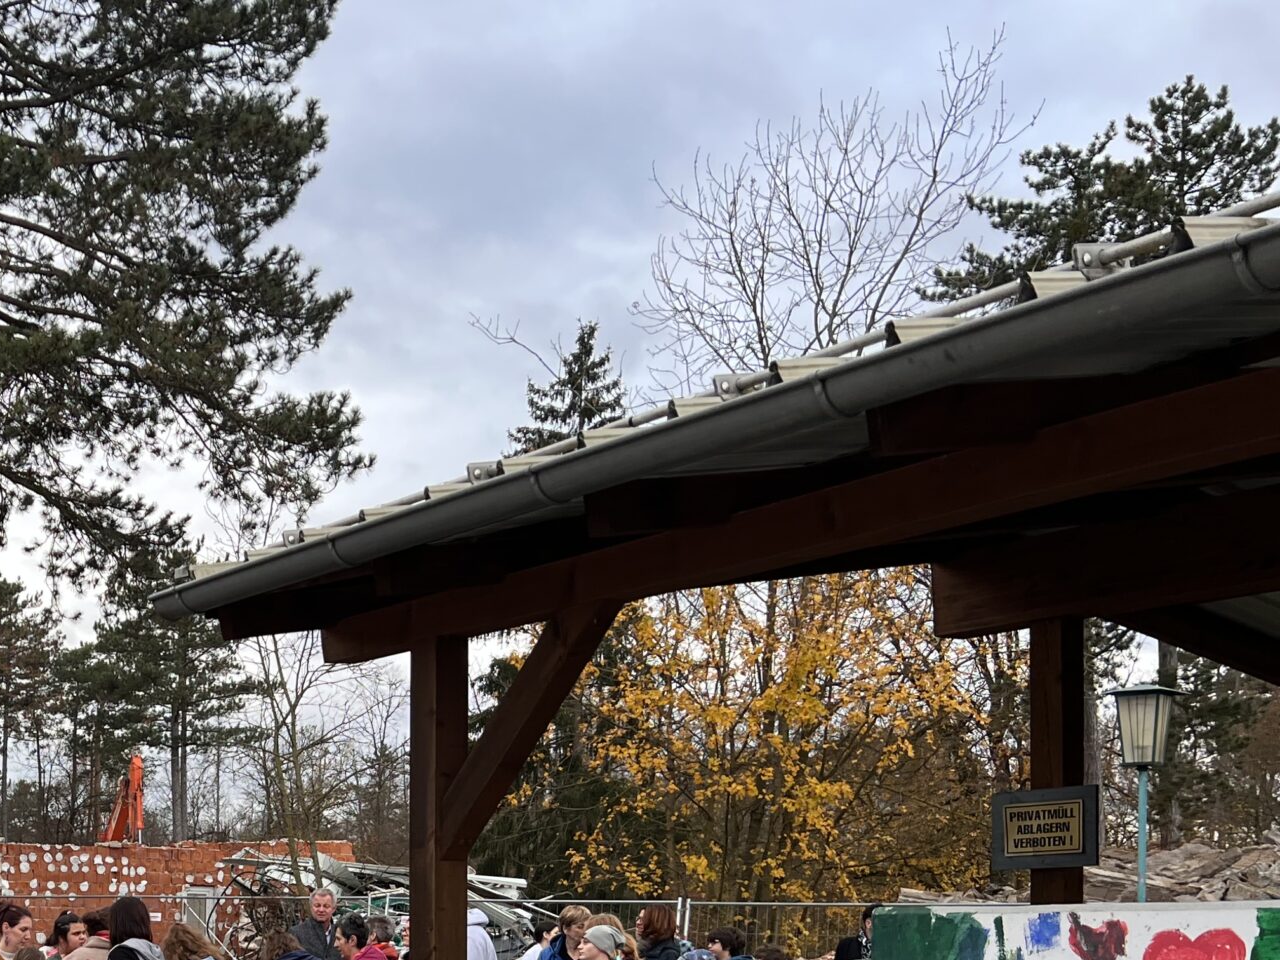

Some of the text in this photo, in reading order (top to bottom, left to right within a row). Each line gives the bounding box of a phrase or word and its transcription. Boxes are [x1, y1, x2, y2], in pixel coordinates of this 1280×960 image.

[1009, 807, 1076, 822] PRIVATMÜLL
[1016, 822, 1070, 835] ABLAGERN
[1013, 836, 1066, 848] VERBOTEN
